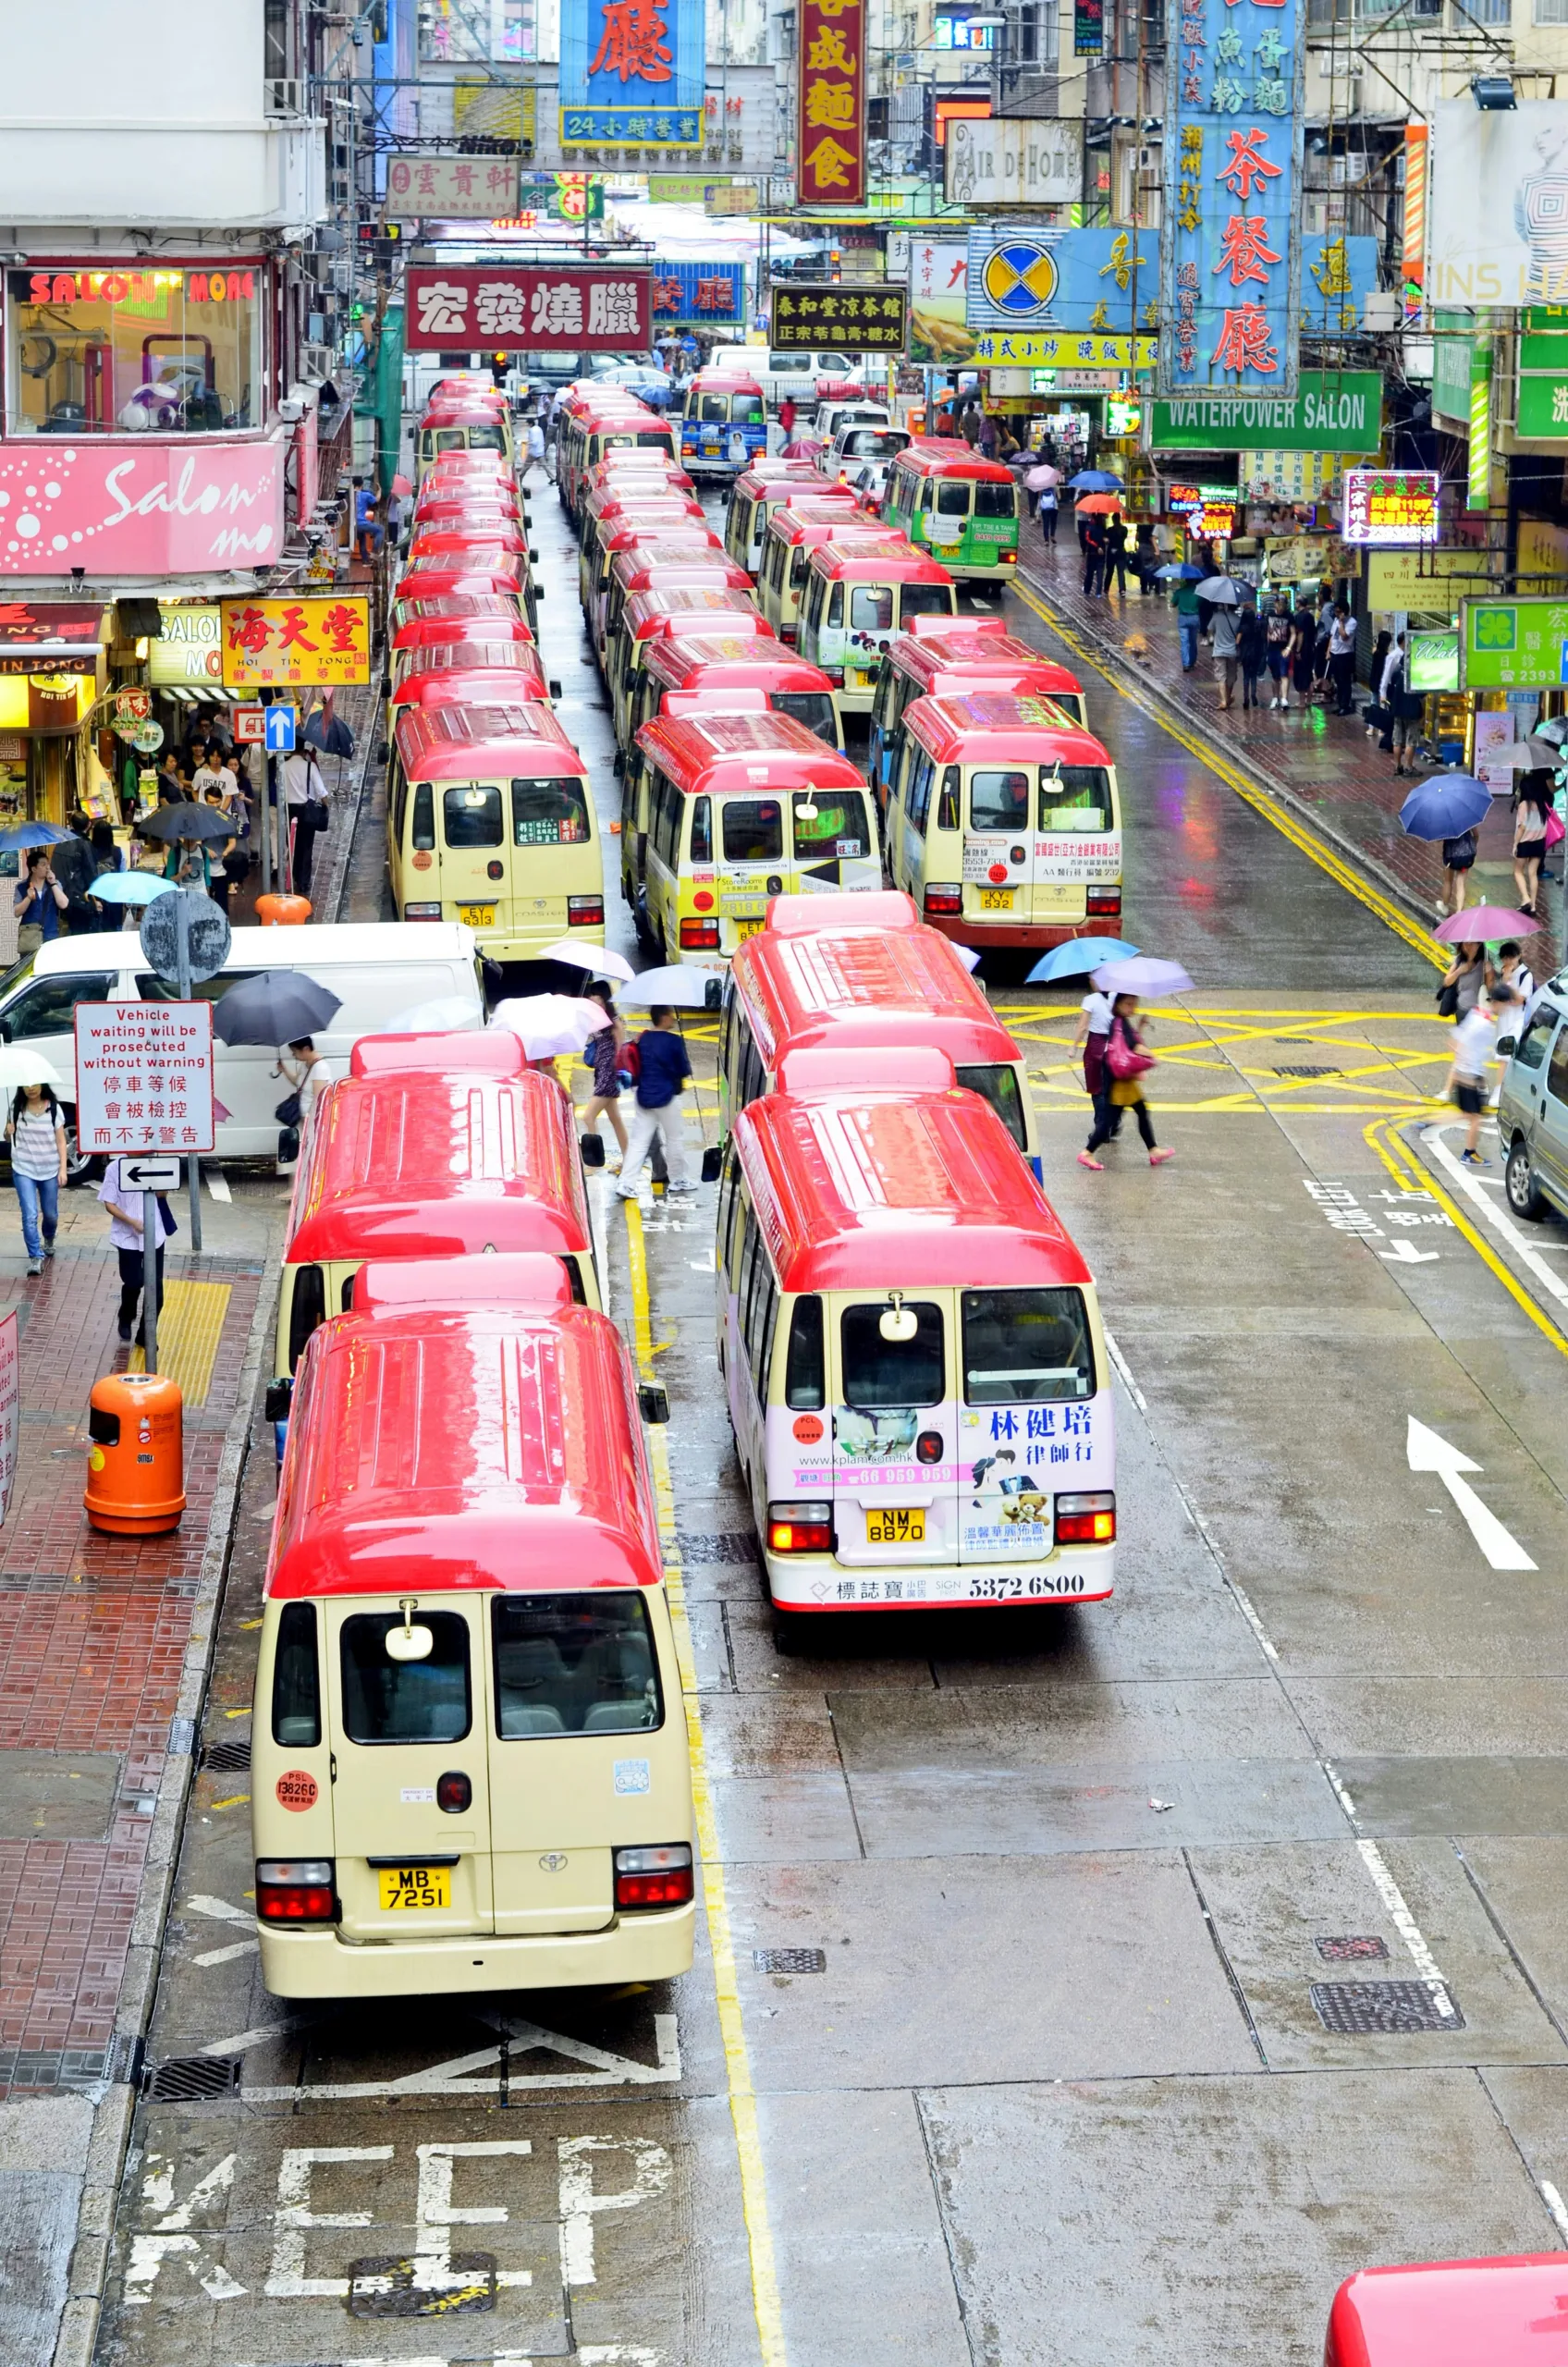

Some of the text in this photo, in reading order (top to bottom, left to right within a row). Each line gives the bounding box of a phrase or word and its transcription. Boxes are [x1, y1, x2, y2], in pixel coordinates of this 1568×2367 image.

[568, 116, 697, 140] 24小時營業
[414, 163, 516, 196] 雲貴軒
[1210, 127, 1284, 374] 茶餐廳
[921, 246, 937, 301] 老字號
[1436, 264, 1502, 300] INS
[30, 274, 156, 304] SALON
[1169, 400, 1296, 429] WATERPOWER
[1303, 392, 1366, 430] SALON
[104, 456, 258, 528] Salon
[227, 604, 364, 655] 海天堂
[31, 659, 86, 671] TONG
[237, 658, 258, 667] HOI
[318, 656, 352, 665] TONG
[1519, 669, 1556, 681] 2393
[1104, 867, 1121, 877] 232
[721, 877, 763, 886] StoreRooms
[985, 900, 1010, 909] 532
[988, 890, 1005, 901] KY
[469, 907, 485, 917] EY
[747, 922, 762, 932] ET
[116, 1009, 170, 1021] Vehicle
[91, 1025, 197, 1037] waiting will be
[103, 1041, 186, 1055] prosecuted
[83, 1056, 205, 1070] without warning
[103, 1075, 188, 1094] 停車等候
[104, 1101, 188, 1120] 會被檢控
[93, 1126, 199, 1145] 而不予警告
[989, 1404, 1094, 1441] 林健培
[799, 1452, 914, 1467] www.kplam.com.hk
[1026, 1441, 1094, 1466] 律師行
[859, 1468, 880, 1484] 66
[886, 1467, 915, 1483] 959
[921, 1466, 952, 1481] 959
[883, 1511, 909, 1526] NM
[869, 1525, 923, 1541] 8870
[969, 1577, 1023, 1600] 5372
[1029, 1574, 1085, 1596] 6800
[288, 1773, 307, 1782] PSL
[398, 1870, 430, 1889] MB
[386, 1889, 444, 1908] 7251
[122, 2135, 674, 2306] KEEP
